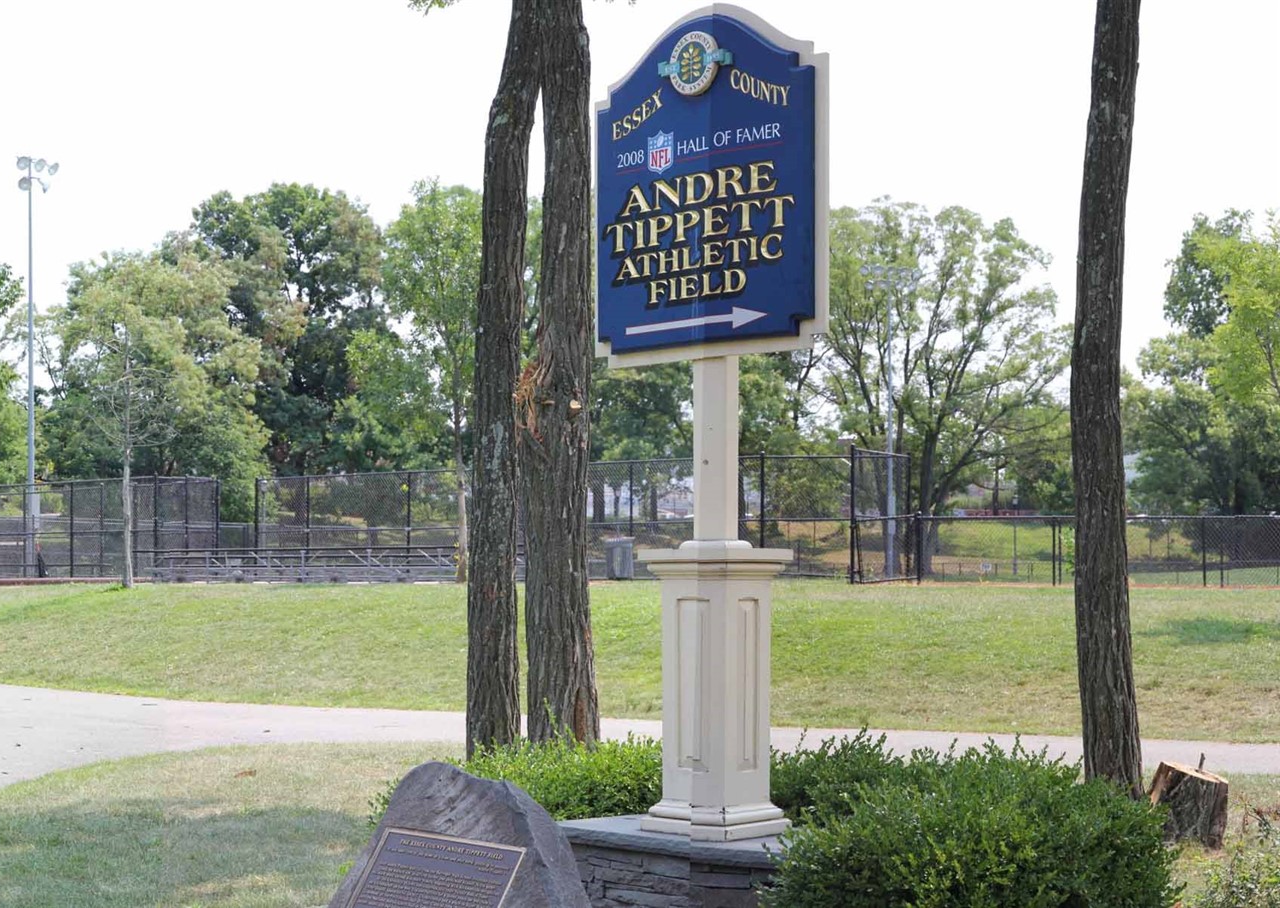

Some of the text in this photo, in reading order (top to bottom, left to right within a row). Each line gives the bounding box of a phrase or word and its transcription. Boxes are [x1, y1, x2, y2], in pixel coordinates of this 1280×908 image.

[612, 70, 790, 141] ESSEX COUNTY
[617, 124, 781, 169] 2008 NFL HALL OF FAMER
[621, 161, 777, 217] ANDRE
[606, 195, 794, 253] TIPPETT
[616, 234, 784, 280] ATHLETIC
[648, 270, 747, 304] FIELD
